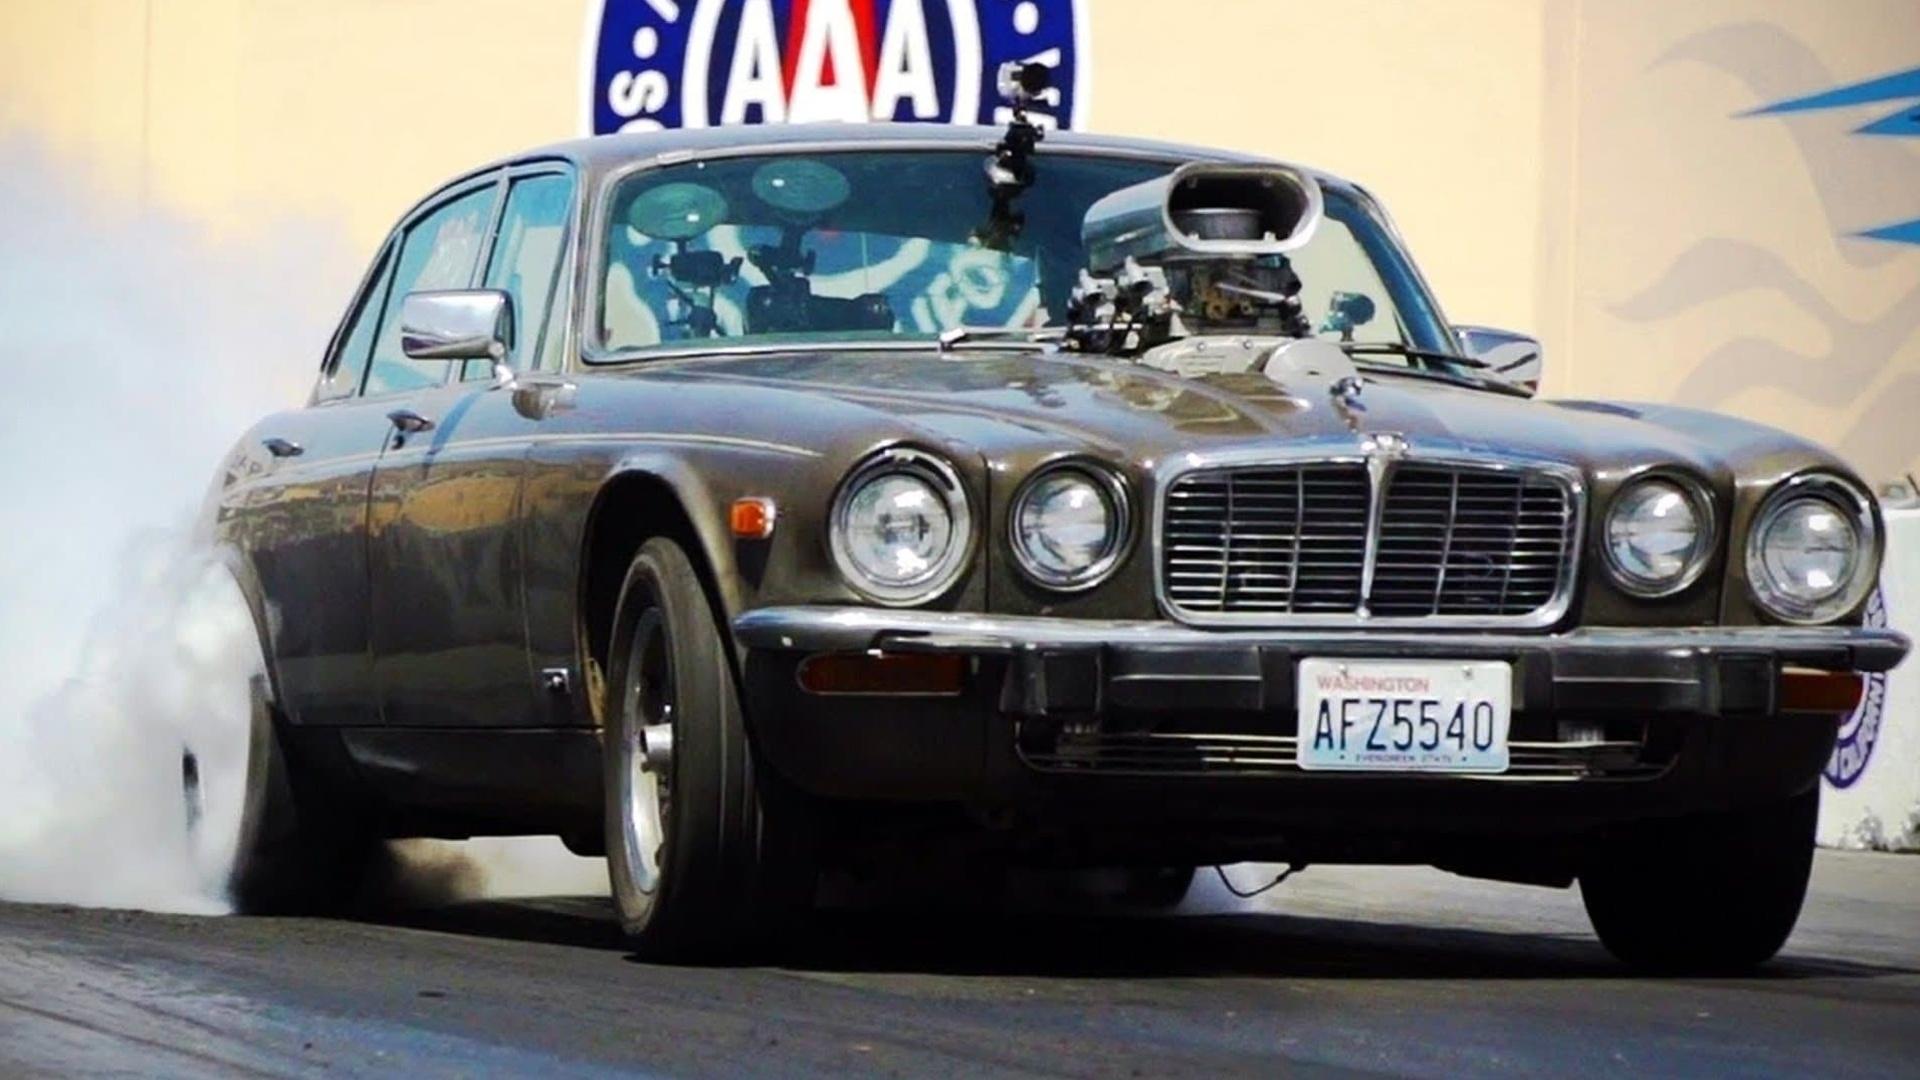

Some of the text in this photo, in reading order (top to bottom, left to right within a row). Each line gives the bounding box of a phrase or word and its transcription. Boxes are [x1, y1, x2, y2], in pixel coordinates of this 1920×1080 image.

[720, 0, 940, 124] AAA
[1316, 675, 1431, 693] WASHINGTON
[1313, 698, 1494, 751] AFZ5540
